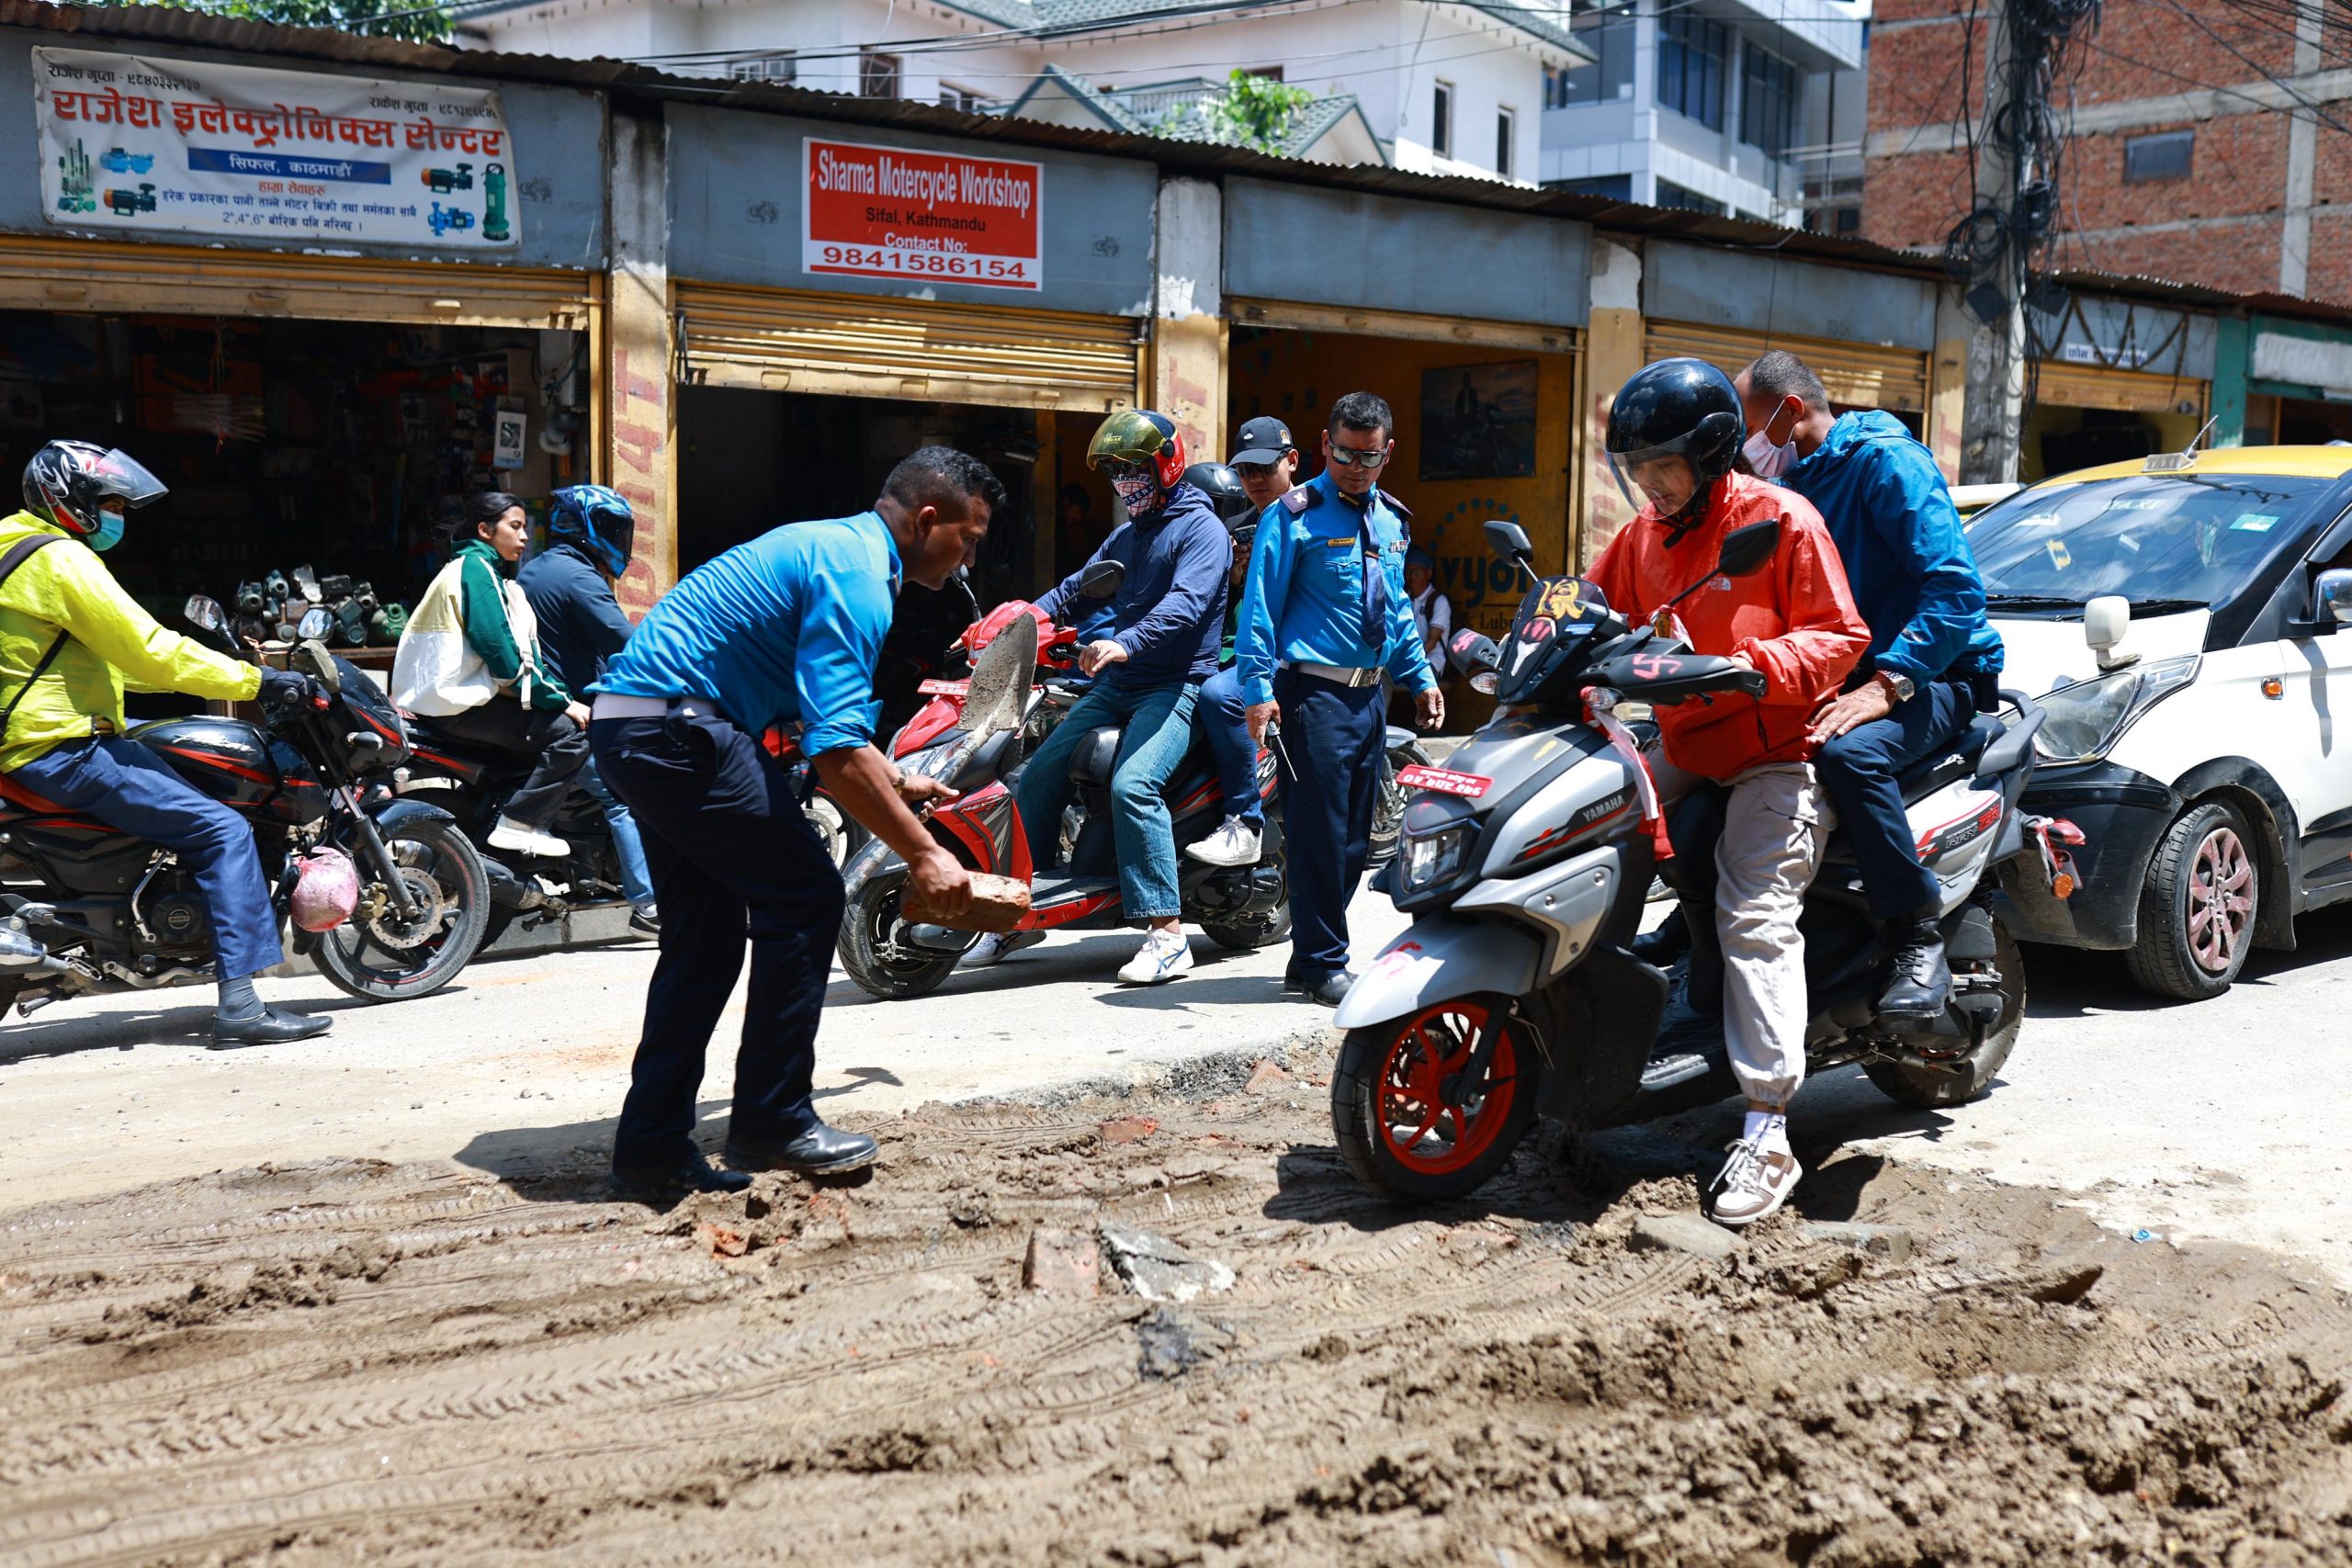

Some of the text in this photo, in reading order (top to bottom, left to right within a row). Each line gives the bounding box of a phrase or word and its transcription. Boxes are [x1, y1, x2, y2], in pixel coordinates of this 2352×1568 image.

[49, 65, 83, 80] राजेश
[86, 69, 116, 84] गुप्ता
[369, 96, 401, 110] राकेश
[404, 100, 429, 114] गुप्ता
[51, 86, 164, 128] राजेश
[403, 117, 504, 157] सेन्टर
[228, 153, 281, 174] सिफल,
[818, 148, 1031, 220] Sharma Motercycle Workshop
[865, 207, 987, 233] Sifal, Kathmandu
[884, 231, 968, 255] Contact No:
[822, 245, 1026, 279] 9841586154
[1582, 795, 1625, 822] YAMAHA
